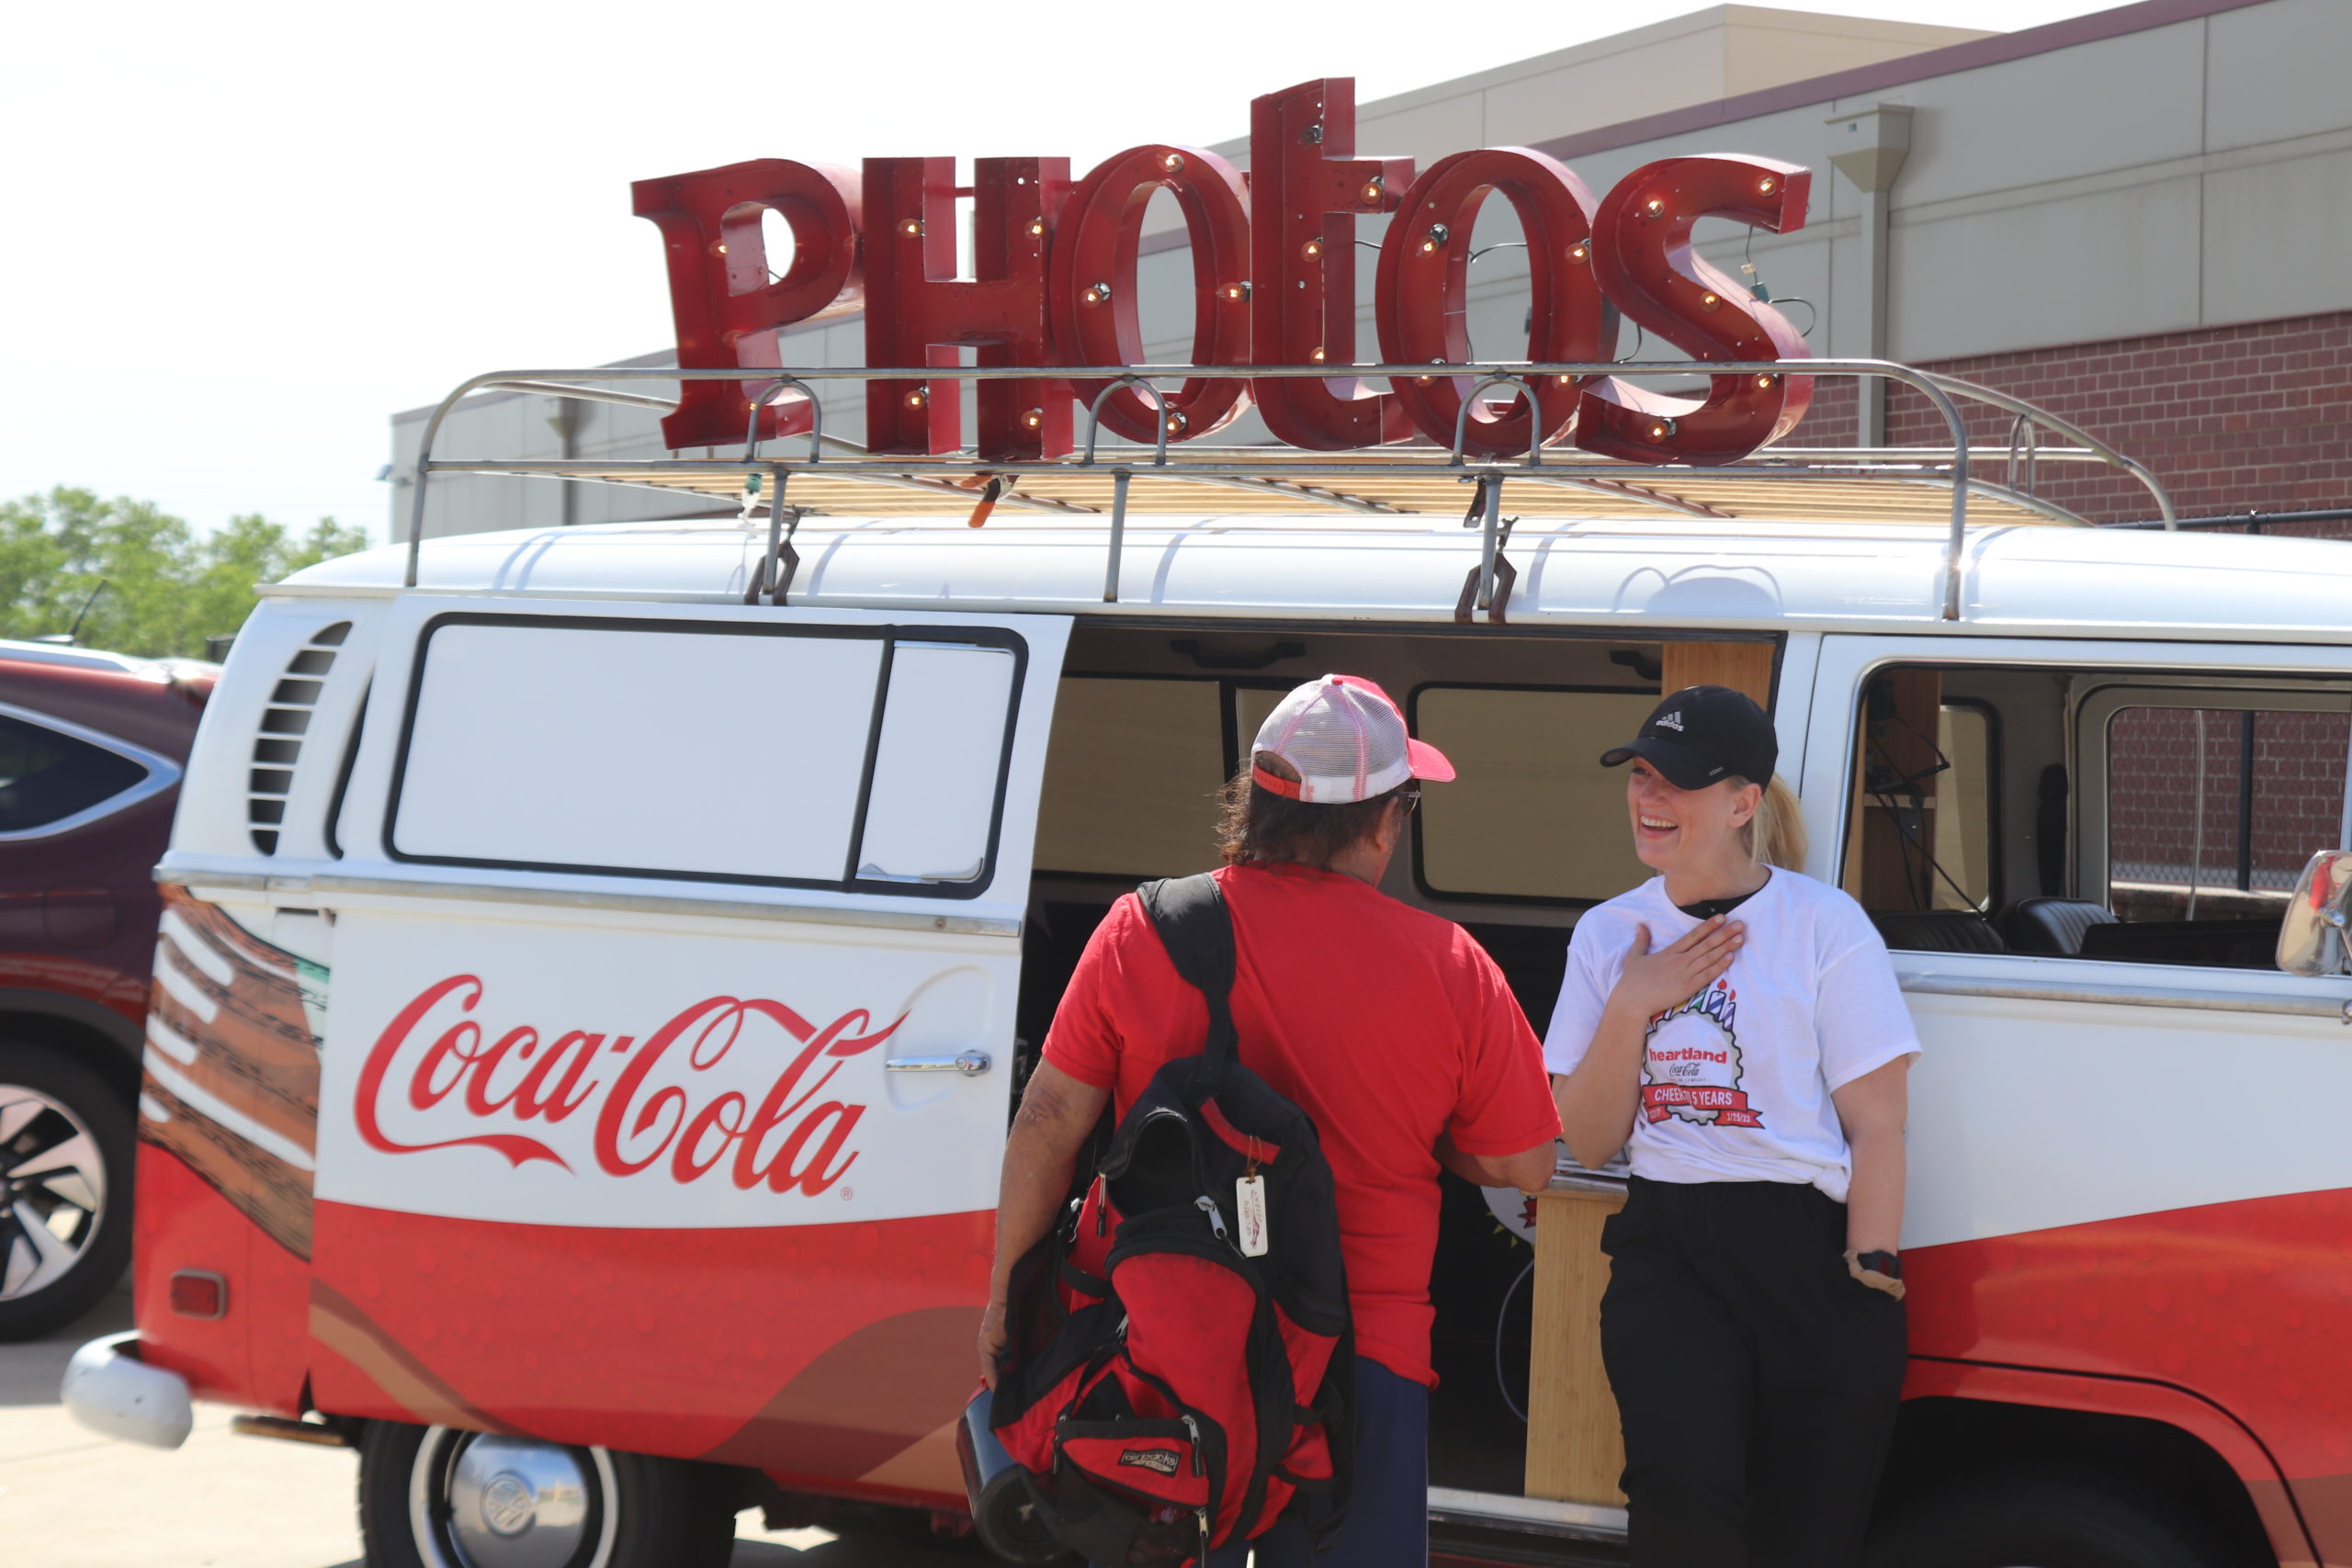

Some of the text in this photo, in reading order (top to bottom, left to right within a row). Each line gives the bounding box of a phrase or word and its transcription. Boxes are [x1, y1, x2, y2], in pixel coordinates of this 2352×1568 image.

[1656, 720, 1683, 732] adidas
[1649, 1047, 1727, 1064] heartland
[353, 974, 911, 1198] Coca-Cola
[1691, 1091, 1698, 1105] 5
[1699, 1090, 1733, 1106] YEARS
